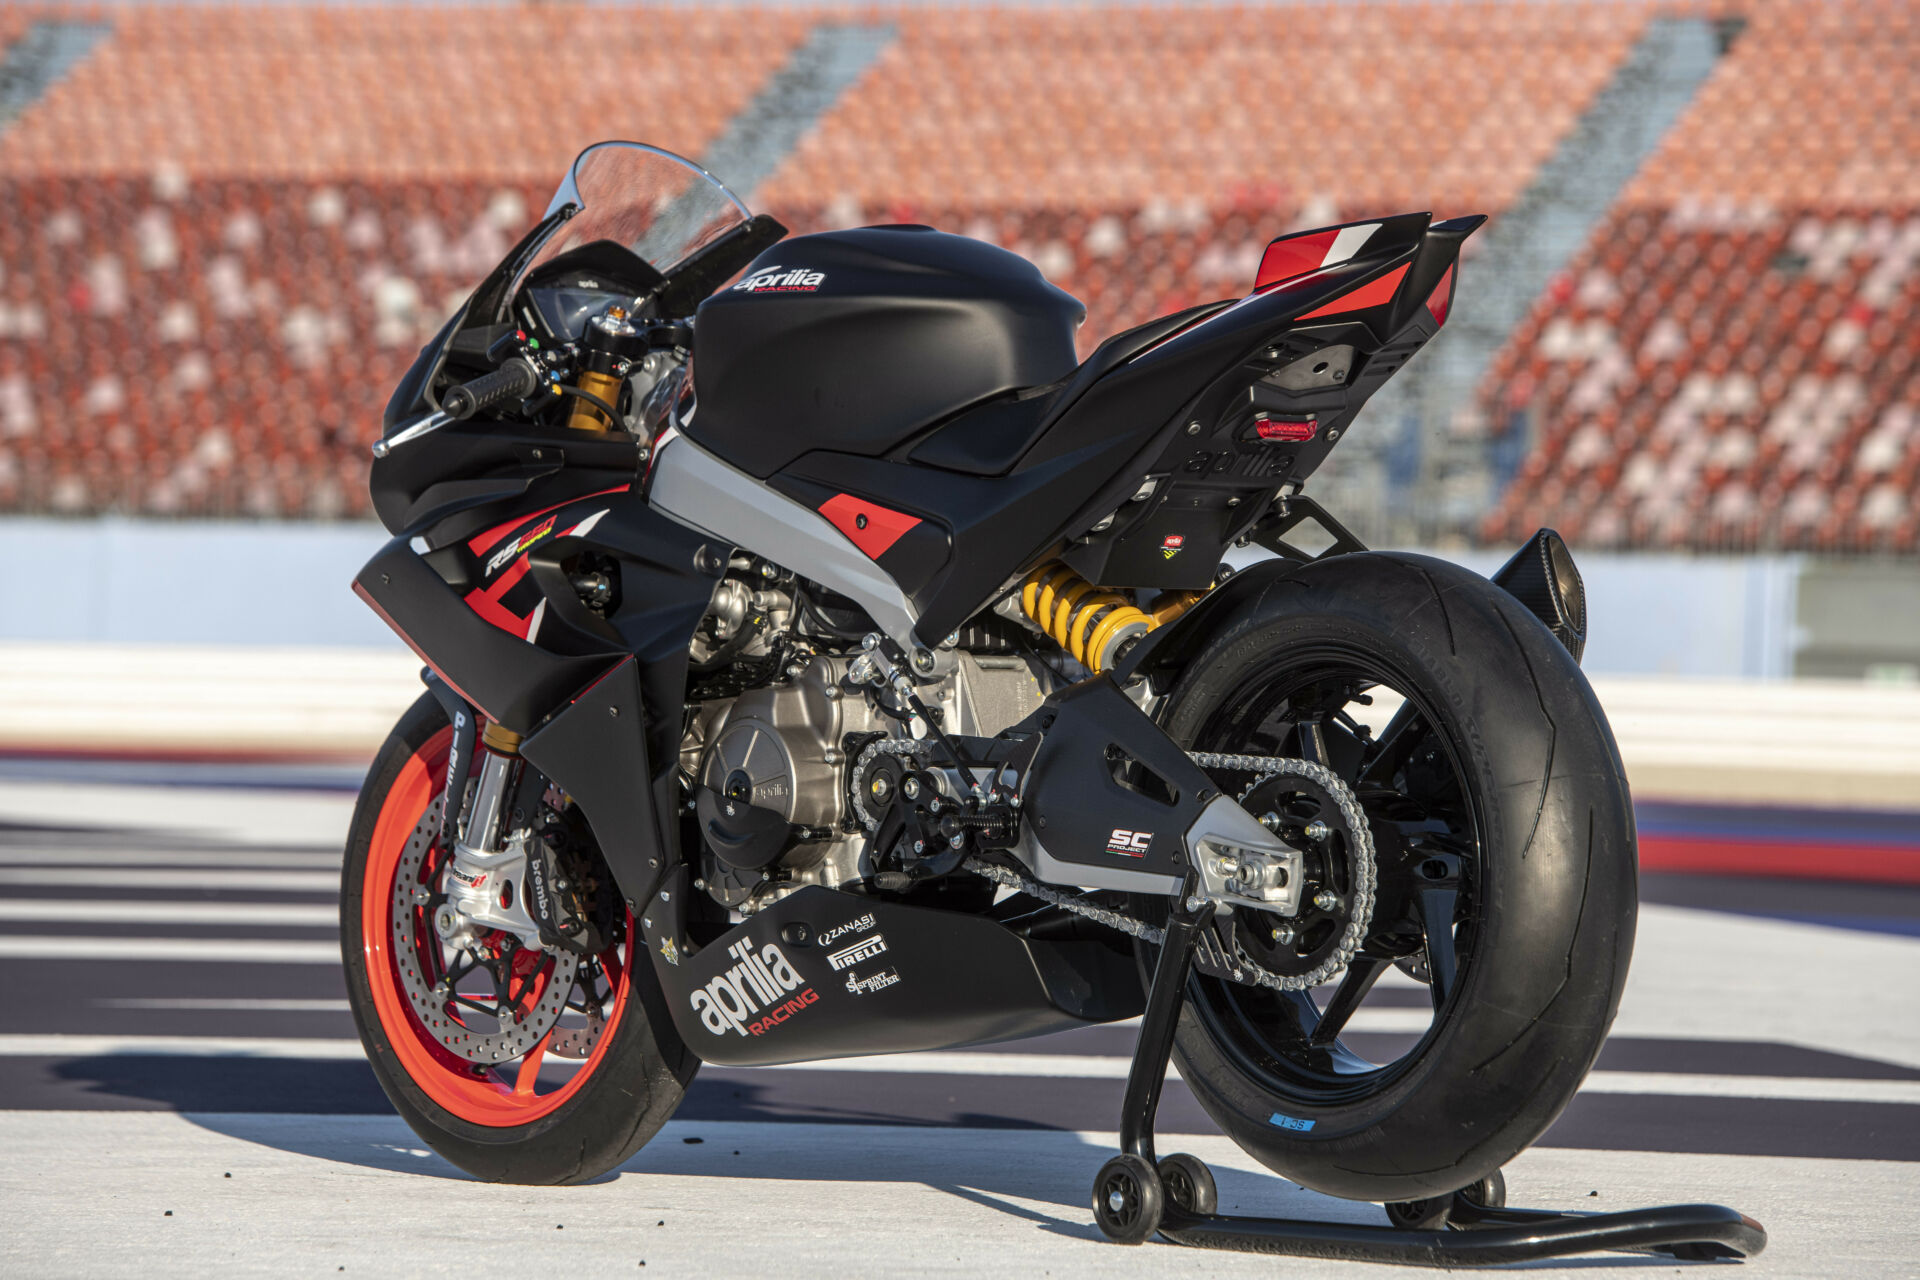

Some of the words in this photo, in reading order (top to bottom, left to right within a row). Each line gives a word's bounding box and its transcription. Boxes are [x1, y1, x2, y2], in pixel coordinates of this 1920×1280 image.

[733, 265, 825, 291] aprilia
[755, 285, 817, 293] RACING
[1184, 446, 1297, 481] aprilia
[755, 783, 789, 800] aprilia
[1107, 843, 1147, 853] PROJECT
[1109, 828, 1152, 849] SC
[531, 858, 550, 920] brembo
[829, 913, 874, 939] ZANASI
[826, 934, 887, 972] PIRELLI
[690, 935, 806, 1037] aprilia
[857, 971, 886, 990] SPRINT
[868, 974, 900, 993] FILTER
[748, 987, 820, 1037] RACING
